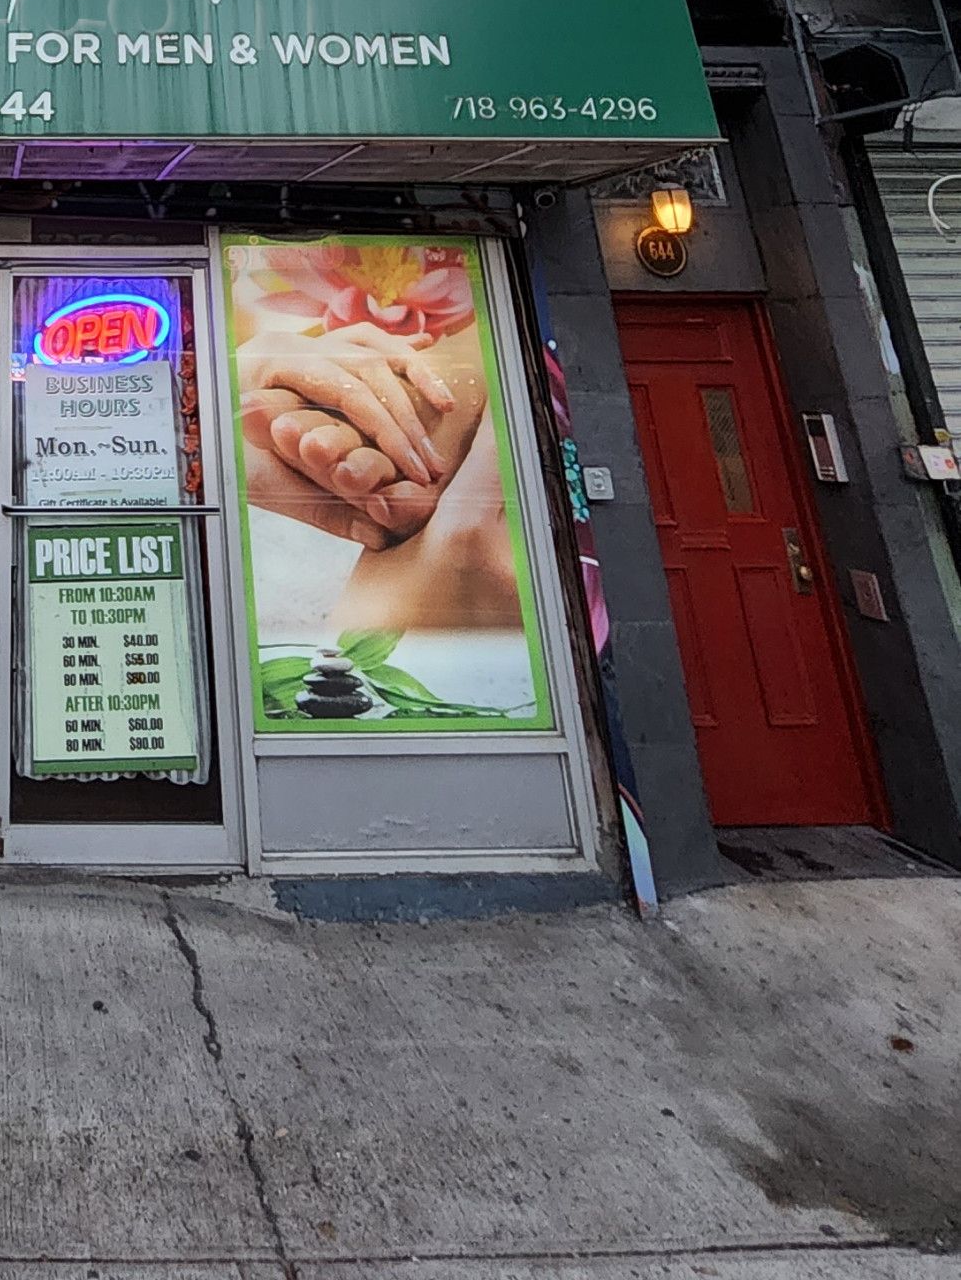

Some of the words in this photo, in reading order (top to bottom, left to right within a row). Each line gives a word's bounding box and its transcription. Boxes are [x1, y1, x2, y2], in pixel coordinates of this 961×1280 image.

[7, 32, 101, 63] FOR
[117, 34, 215, 65] MEN
[228, 35, 258, 66] &
[270, 35, 452, 67] WOMEN
[509, 97, 658, 122] 963-4296
[649, 241, 676, 260] 644
[46, 308, 156, 358] OPEN
[46, 376, 153, 394] BUSINESS
[59, 399, 141, 418] HOURS
[35, 537, 111, 577] PRICE
[118, 536, 174, 574] LIST
[58, 588, 96, 604] FROM
[99, 586, 156, 603] 10:30AM
[71, 610, 87, 624] TO
[91, 608, 146, 624] 10:30PM
[62, 637, 75, 649] 30
[78, 636, 100, 648] MIN.
[123, 634, 159, 647] $40.00
[63, 655, 76, 667] 60
[79, 654, 102, 667] MIN.
[64, 674, 77, 686] 80
[79, 673, 103, 686] MIN.
[65, 696, 104, 712] AFTER
[107, 694, 161, 711] 10:30PM
[65, 720, 78, 733] 60
[81, 719, 104, 732] MIN.
[129, 718, 164, 731] $60.00
[66, 739, 79, 752] 80
[82, 738, 106, 752] MIN.
